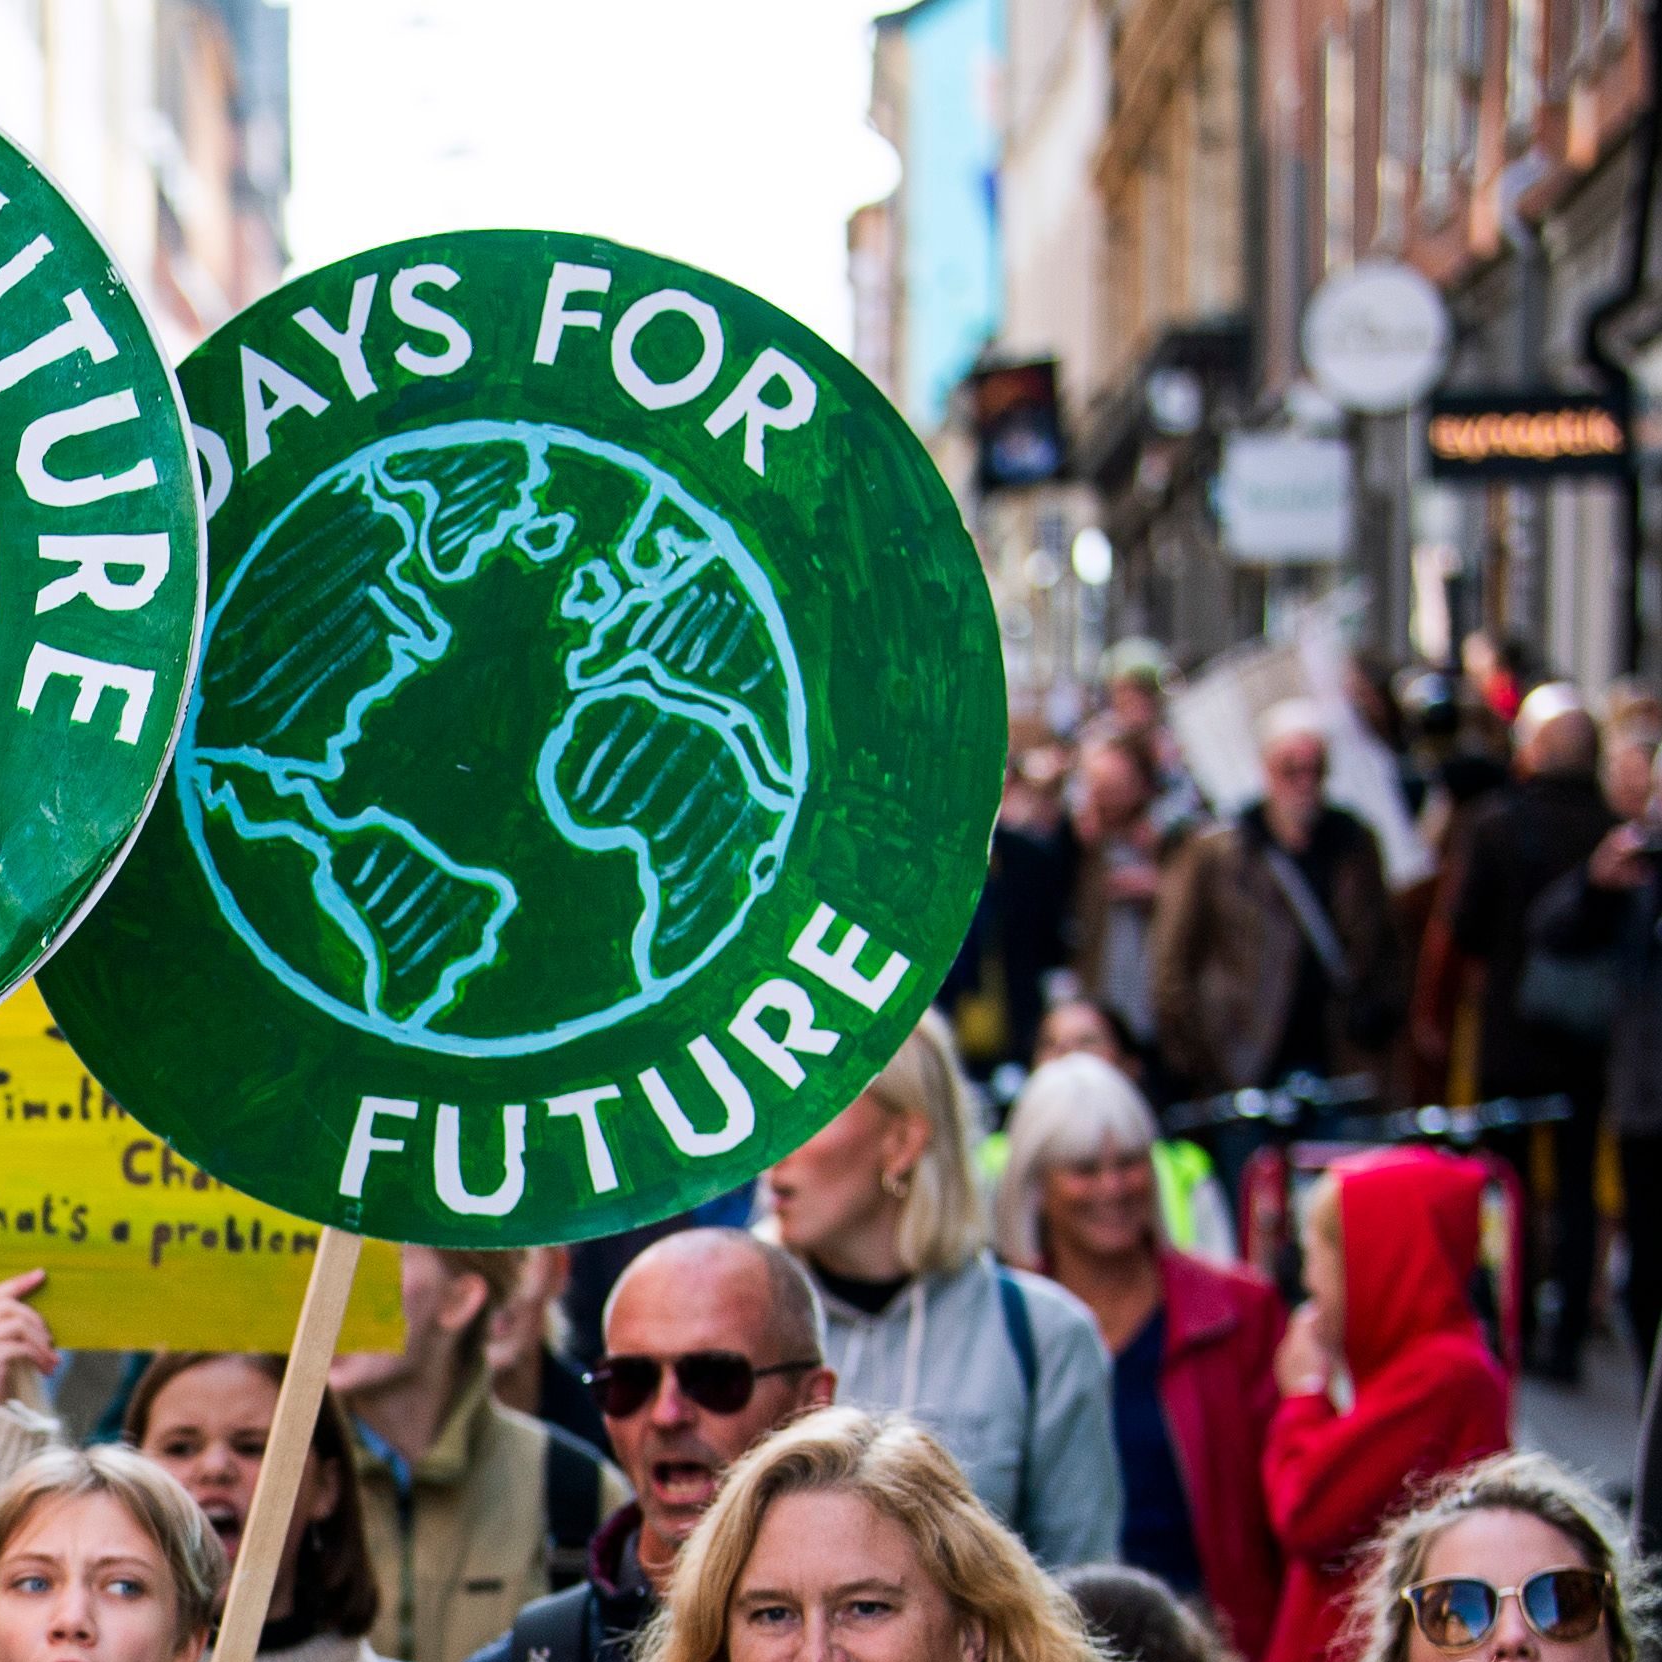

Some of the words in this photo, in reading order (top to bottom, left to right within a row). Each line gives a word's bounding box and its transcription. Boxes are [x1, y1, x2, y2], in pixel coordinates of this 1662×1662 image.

[532, 261, 817, 477] FOR
[337, 900, 912, 1216] FUTURE
[112, 1219, 130, 1244] a
[149, 1213, 319, 1268] problem
